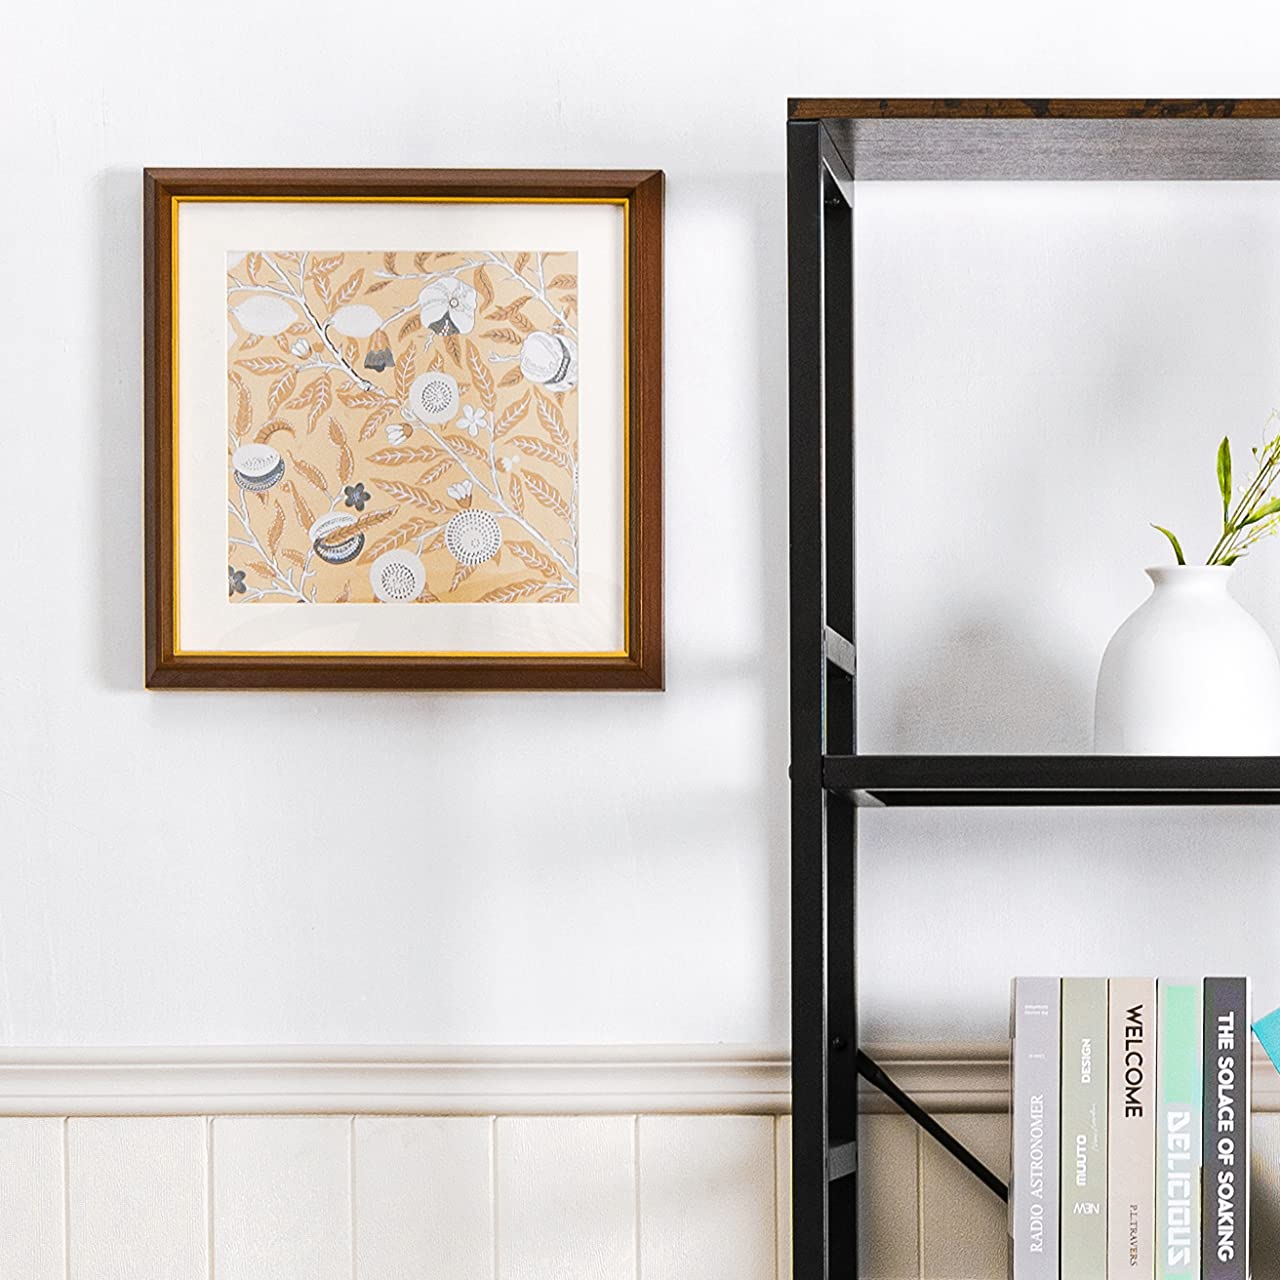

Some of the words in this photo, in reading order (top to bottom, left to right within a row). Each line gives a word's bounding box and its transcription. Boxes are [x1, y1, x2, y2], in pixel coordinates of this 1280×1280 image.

[1081, 1038, 1092, 1084] DESIGN
[1125, 1004, 1143, 1118] WELCOME
[1218, 1011, 1234, 1050] THE
[1218, 1056, 1234, 1132] SOLACE
[1030, 1094, 1043, 1199] ASTRONOMER
[1218, 1138, 1234, 1166] OF
[1073, 1202, 1100, 1215] NEW
[1167, 1111, 1191, 1267] DELICIOUS
[1218, 1171, 1234, 1262] SOAKING
[1030, 1204, 1043, 1252] RADIO
